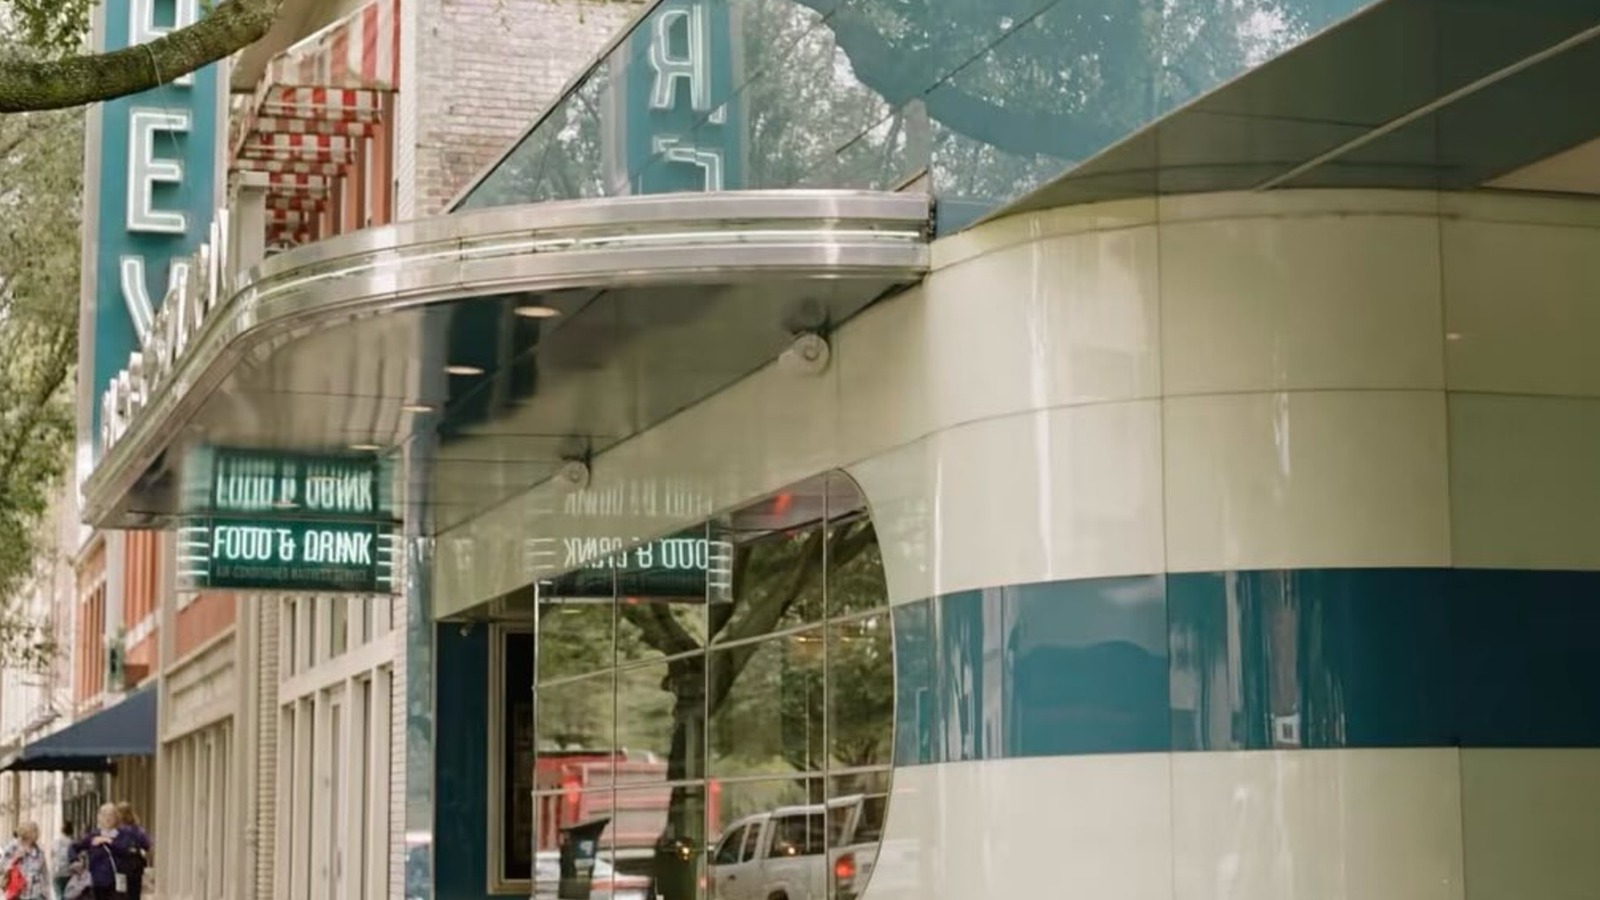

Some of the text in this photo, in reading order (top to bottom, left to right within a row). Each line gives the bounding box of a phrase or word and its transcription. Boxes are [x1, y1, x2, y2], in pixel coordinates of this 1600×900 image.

[213, 525, 373, 565] FOOD & DRINK
